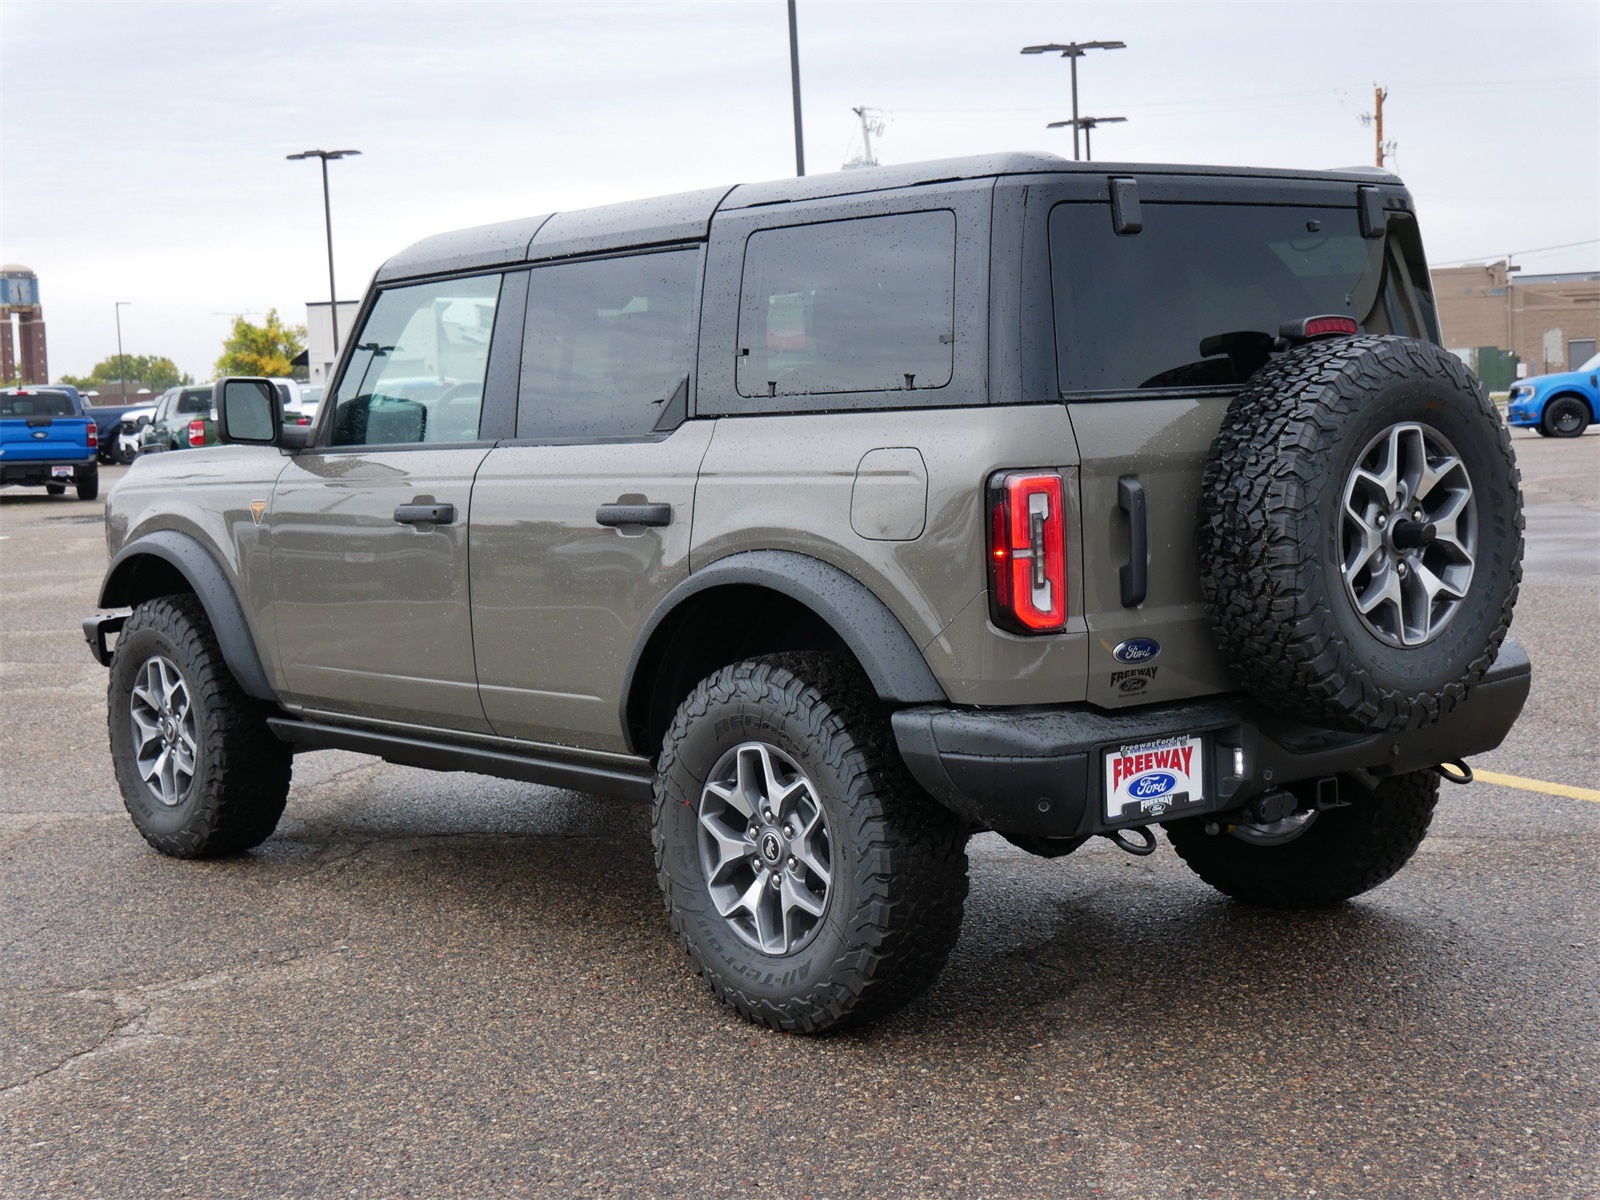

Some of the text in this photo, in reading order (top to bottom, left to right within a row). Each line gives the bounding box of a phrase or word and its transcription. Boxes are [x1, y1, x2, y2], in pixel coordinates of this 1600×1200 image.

[1125, 644, 1151, 659] Ford
[1110, 666, 1158, 687] FREEWAY
[1120, 734, 1190, 751] FreewayFord.net
[1113, 746, 1193, 794] FREEWAY
[1137, 776, 1167, 795] Ford
